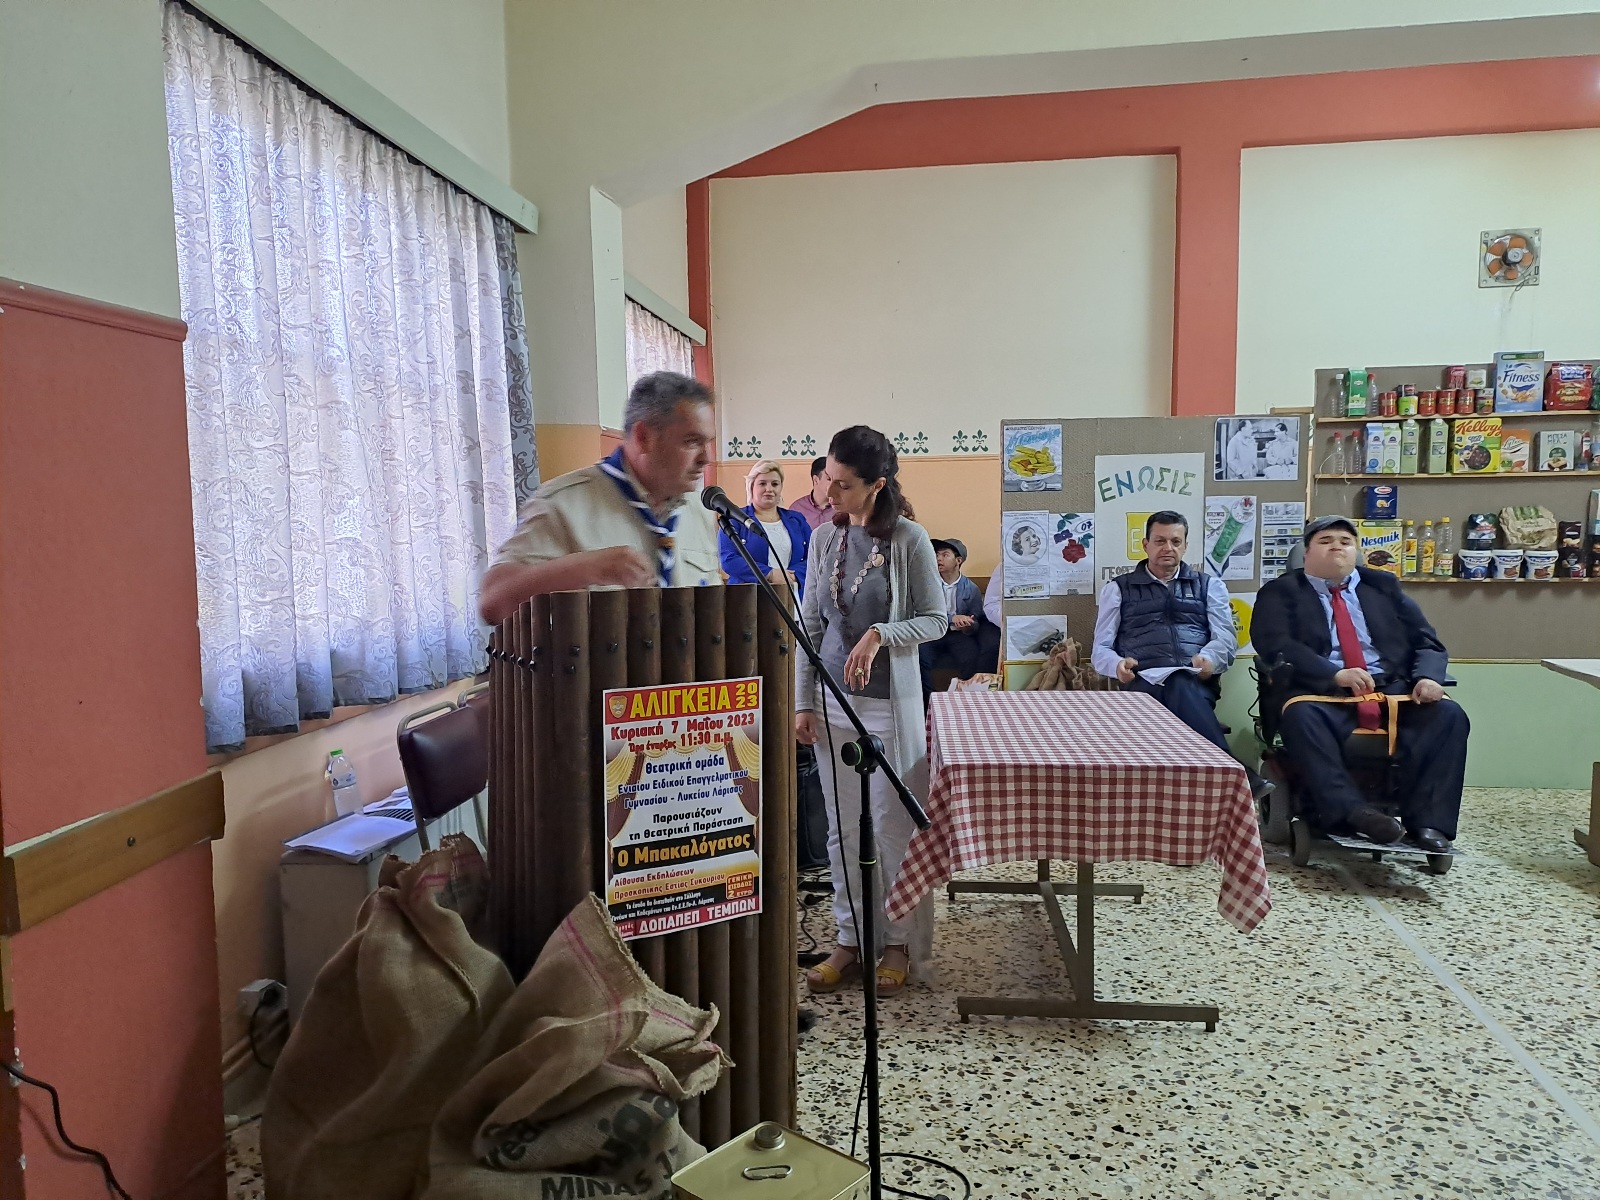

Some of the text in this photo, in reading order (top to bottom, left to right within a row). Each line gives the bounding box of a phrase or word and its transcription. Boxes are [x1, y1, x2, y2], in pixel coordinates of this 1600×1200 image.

[1503, 369, 1540, 383] Fitness
[1097, 465, 1197, 502] ΕΝΩΣΙΣ
[1361, 531, 1400, 547] Nesquik
[735, 682, 758, 696] 20
[630, 686, 731, 718] ΑΛΙΓΚΕΙΑ
[735, 695, 758, 708] 23
[611, 721, 664, 741] Κυριακή
[671, 721, 679, 733] 7
[727, 712, 755, 728] 2023
[680, 731, 710, 747] 11:30
[695, 754, 724, 769] ομάδα
[618, 767, 748, 794] Ενιαίου Ειδικού Επαγγελματικού
[624, 795, 668, 809] Γυμνασίου
[677, 790, 710, 802] Λυκείου
[712, 784, 743, 797] Λάρισας
[653, 806, 723, 824] Παρουσιάζουν
[629, 832, 640, 841] τη
[693, 816, 744, 832] Παράσταση
[634, 833, 751, 864] Μπακαλόγατος
[614, 868, 695, 888] Αίθουσα Εκδηλώσεων
[614, 884, 663, 900] Προσκοπικής
[665, 880, 688, 891] Εστίας
[728, 890, 735, 898] 2
[638, 898, 756, 934] ΔΟΠΑΠΕΠ ΤΕΜΠΩΝ
[541, 1169, 653, 1200] MINAS
